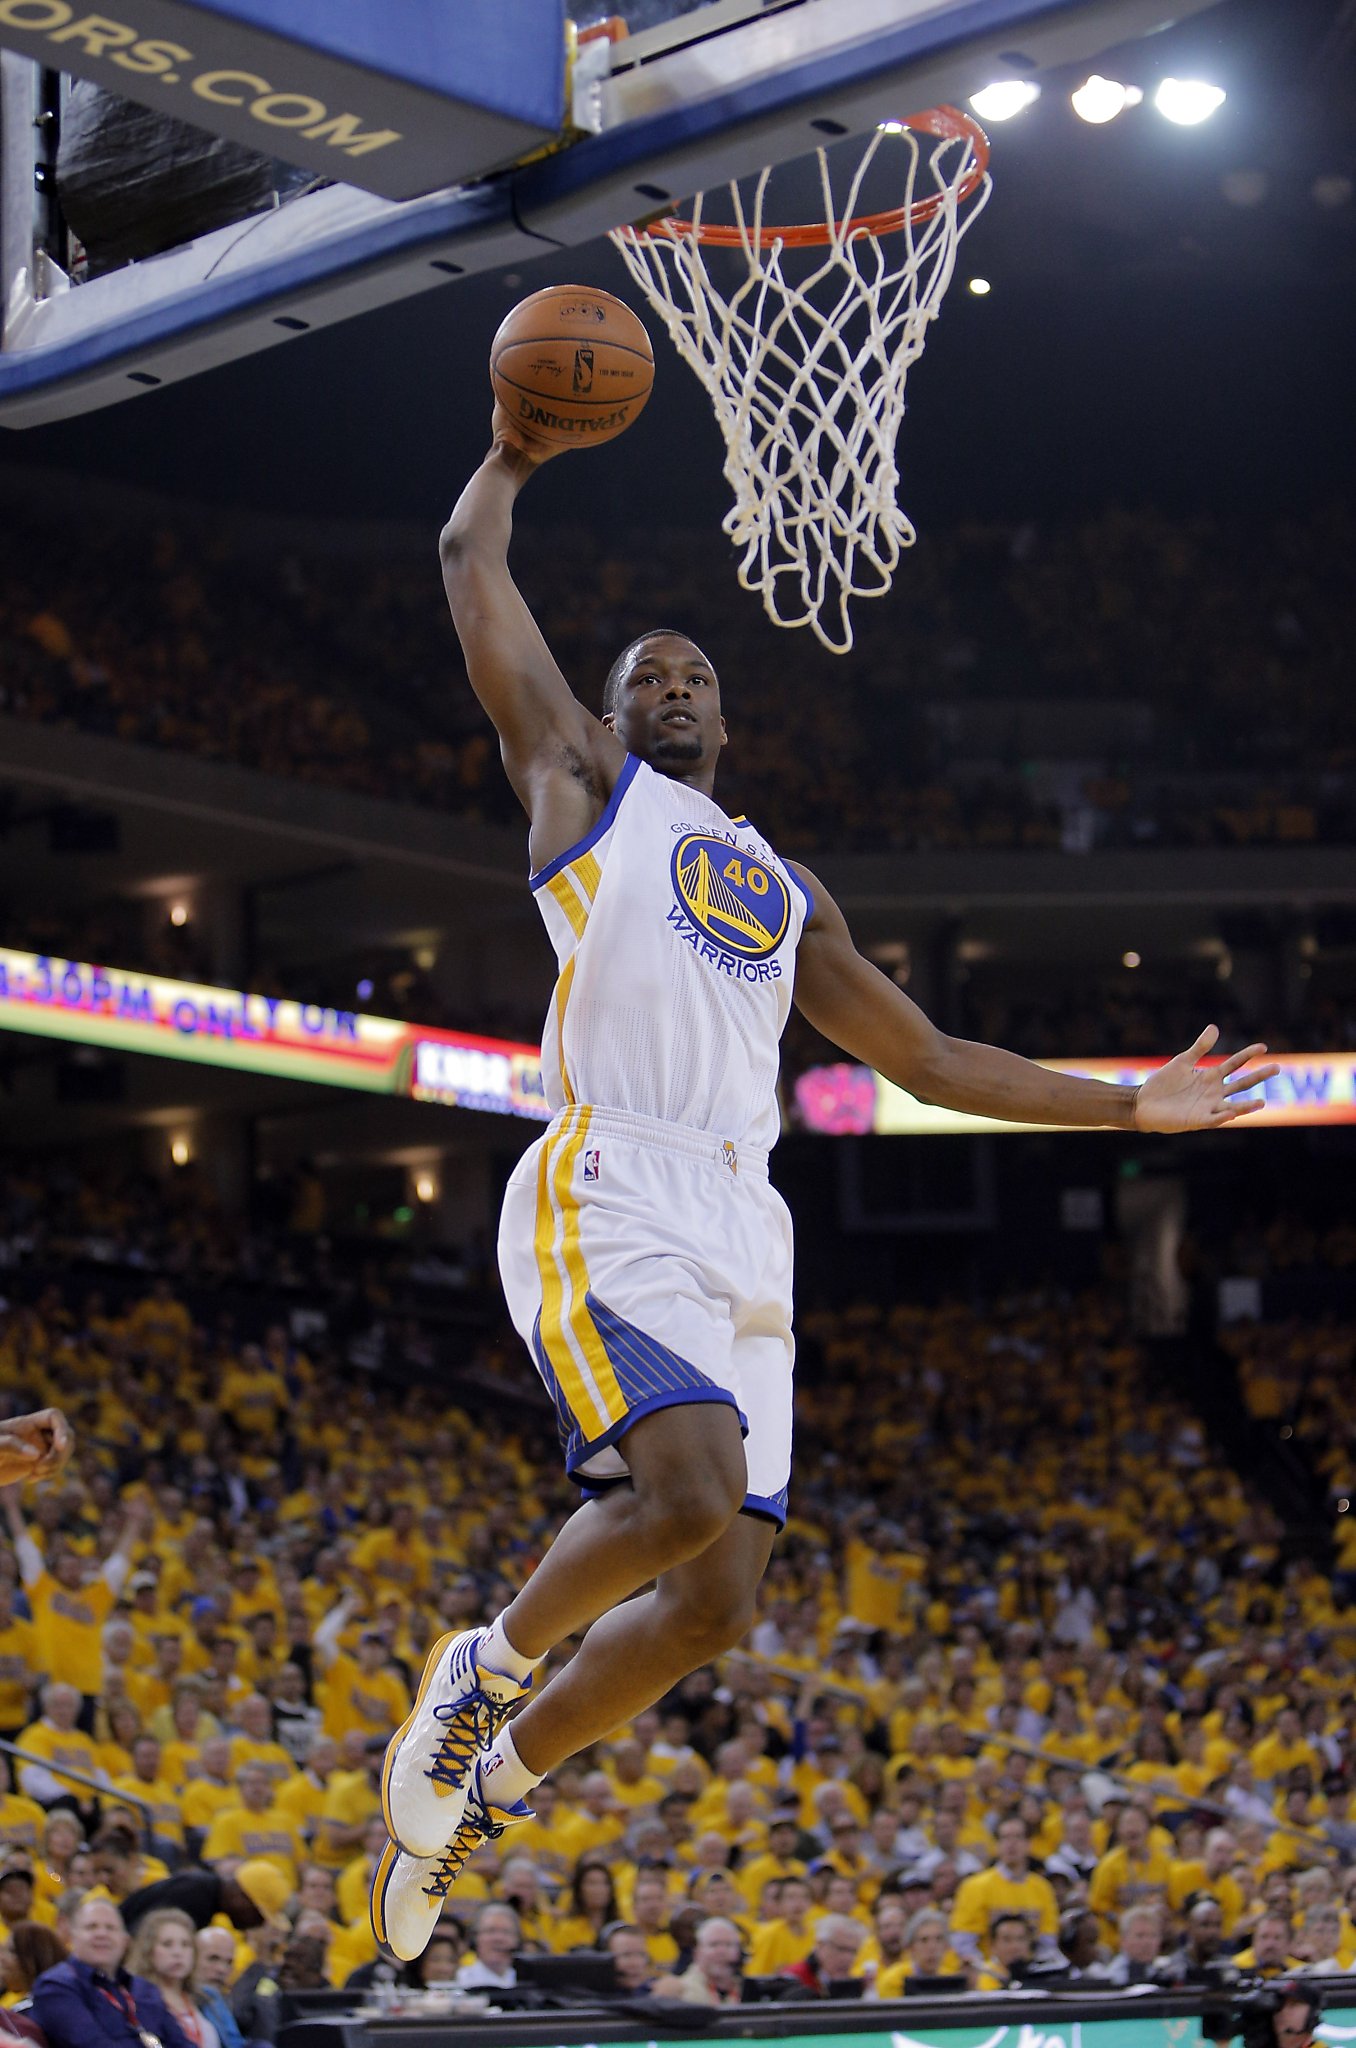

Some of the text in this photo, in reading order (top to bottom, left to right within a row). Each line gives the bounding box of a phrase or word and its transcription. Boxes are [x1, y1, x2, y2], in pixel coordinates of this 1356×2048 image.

[0, 0, 402, 157] ORS.COM
[518, 396, 628, 432] SPALDING
[670, 822, 738, 847] GOLDEN
[723, 858, 770, 896] 40
[666, 904, 782, 983] WARRIORS
[172, 992, 282, 1041] ONLY
